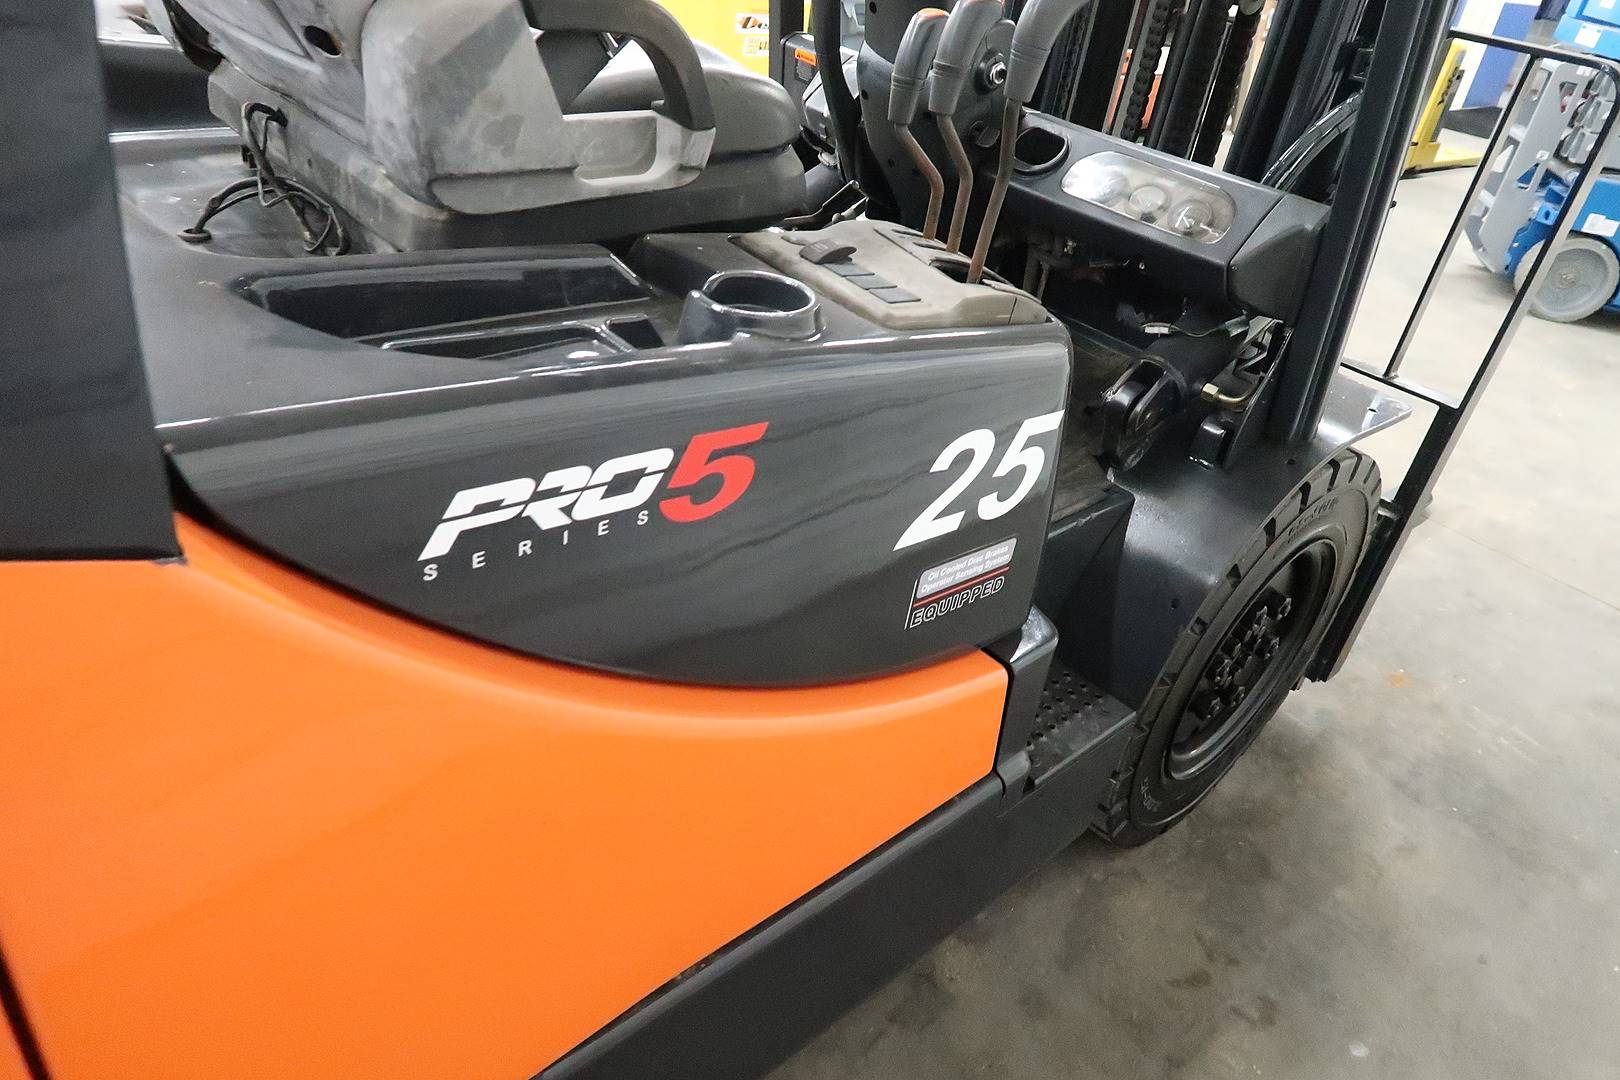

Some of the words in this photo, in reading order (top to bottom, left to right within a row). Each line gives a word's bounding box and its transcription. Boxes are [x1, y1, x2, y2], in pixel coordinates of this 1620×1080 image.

[893, 409, 1066, 551] 25
[423, 510, 649, 581] SERIES
[940, 560, 968, 576] Cooled
[984, 545, 1009, 560] Brakes
[921, 575, 954, 594] Operator
[954, 564, 984, 580] Sensing
[984, 554, 1010, 569] System
[910, 575, 1005, 628] EQUIPPED
